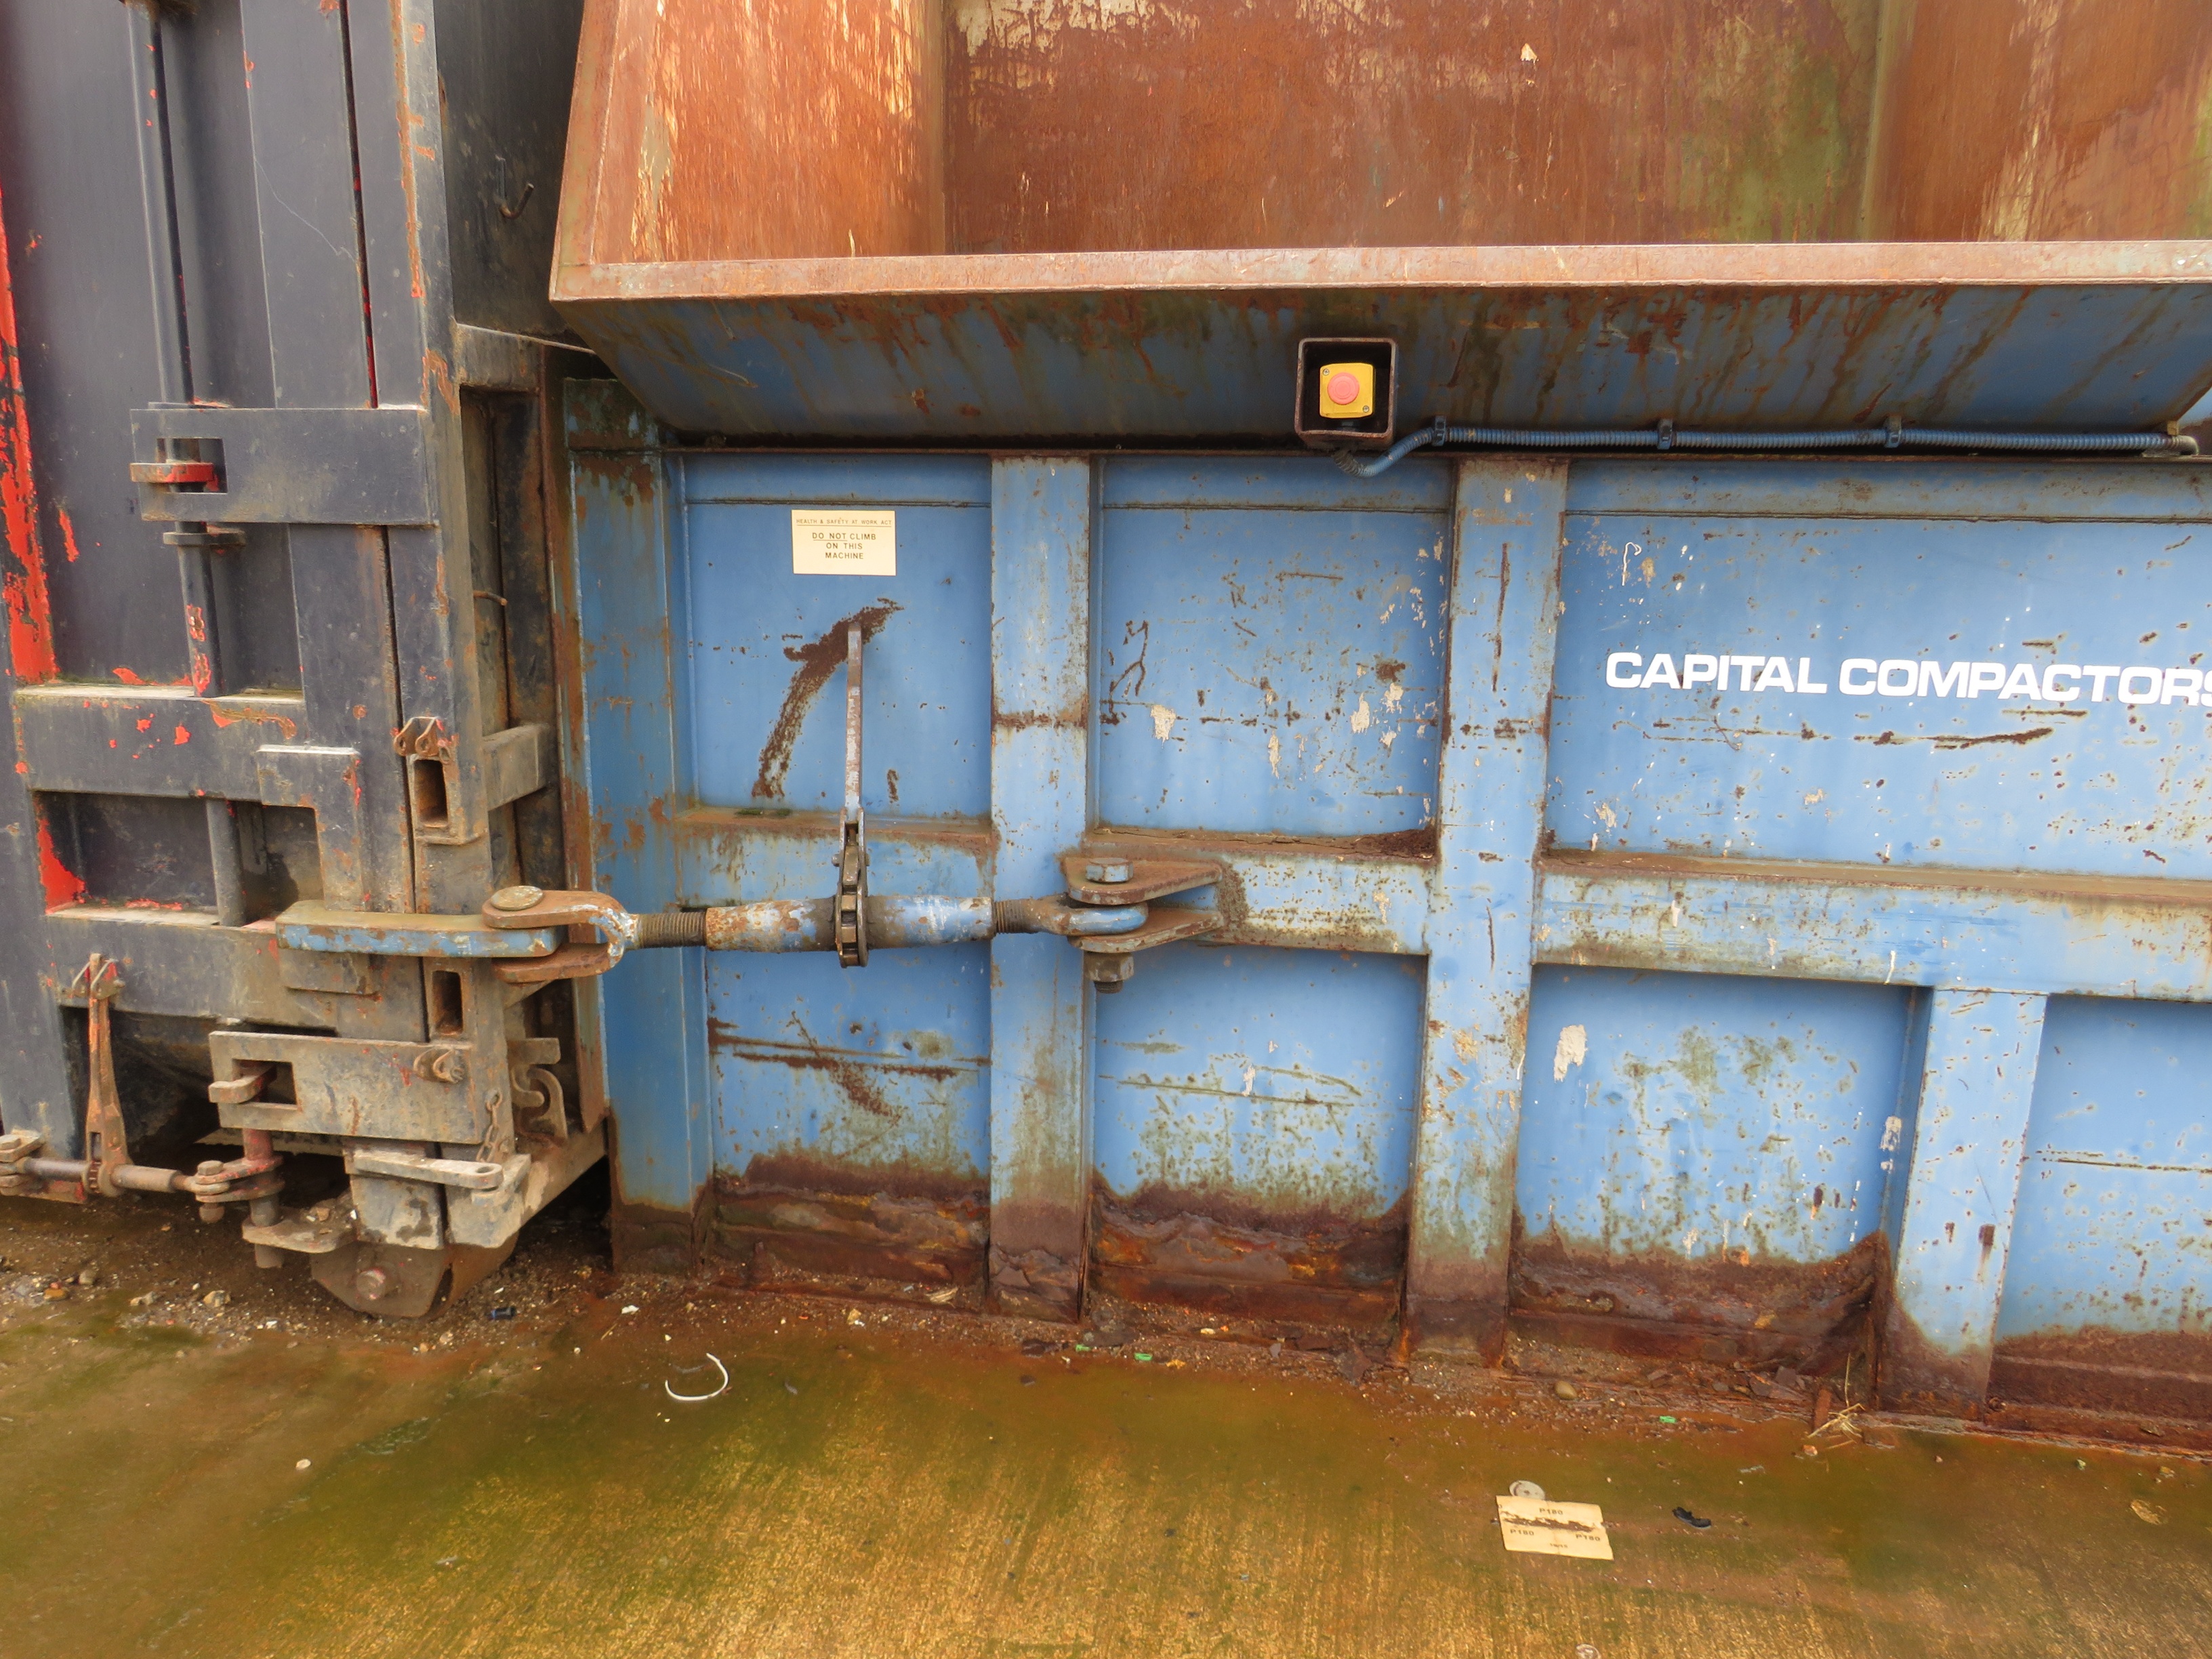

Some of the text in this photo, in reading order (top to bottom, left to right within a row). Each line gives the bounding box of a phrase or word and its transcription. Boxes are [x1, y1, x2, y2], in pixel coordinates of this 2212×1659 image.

[825, 552, 864, 560] MACHINE
[1605, 651, 2212, 707] CAPITAL COMPACTOR
[1538, 1507, 1564, 1515] P180
